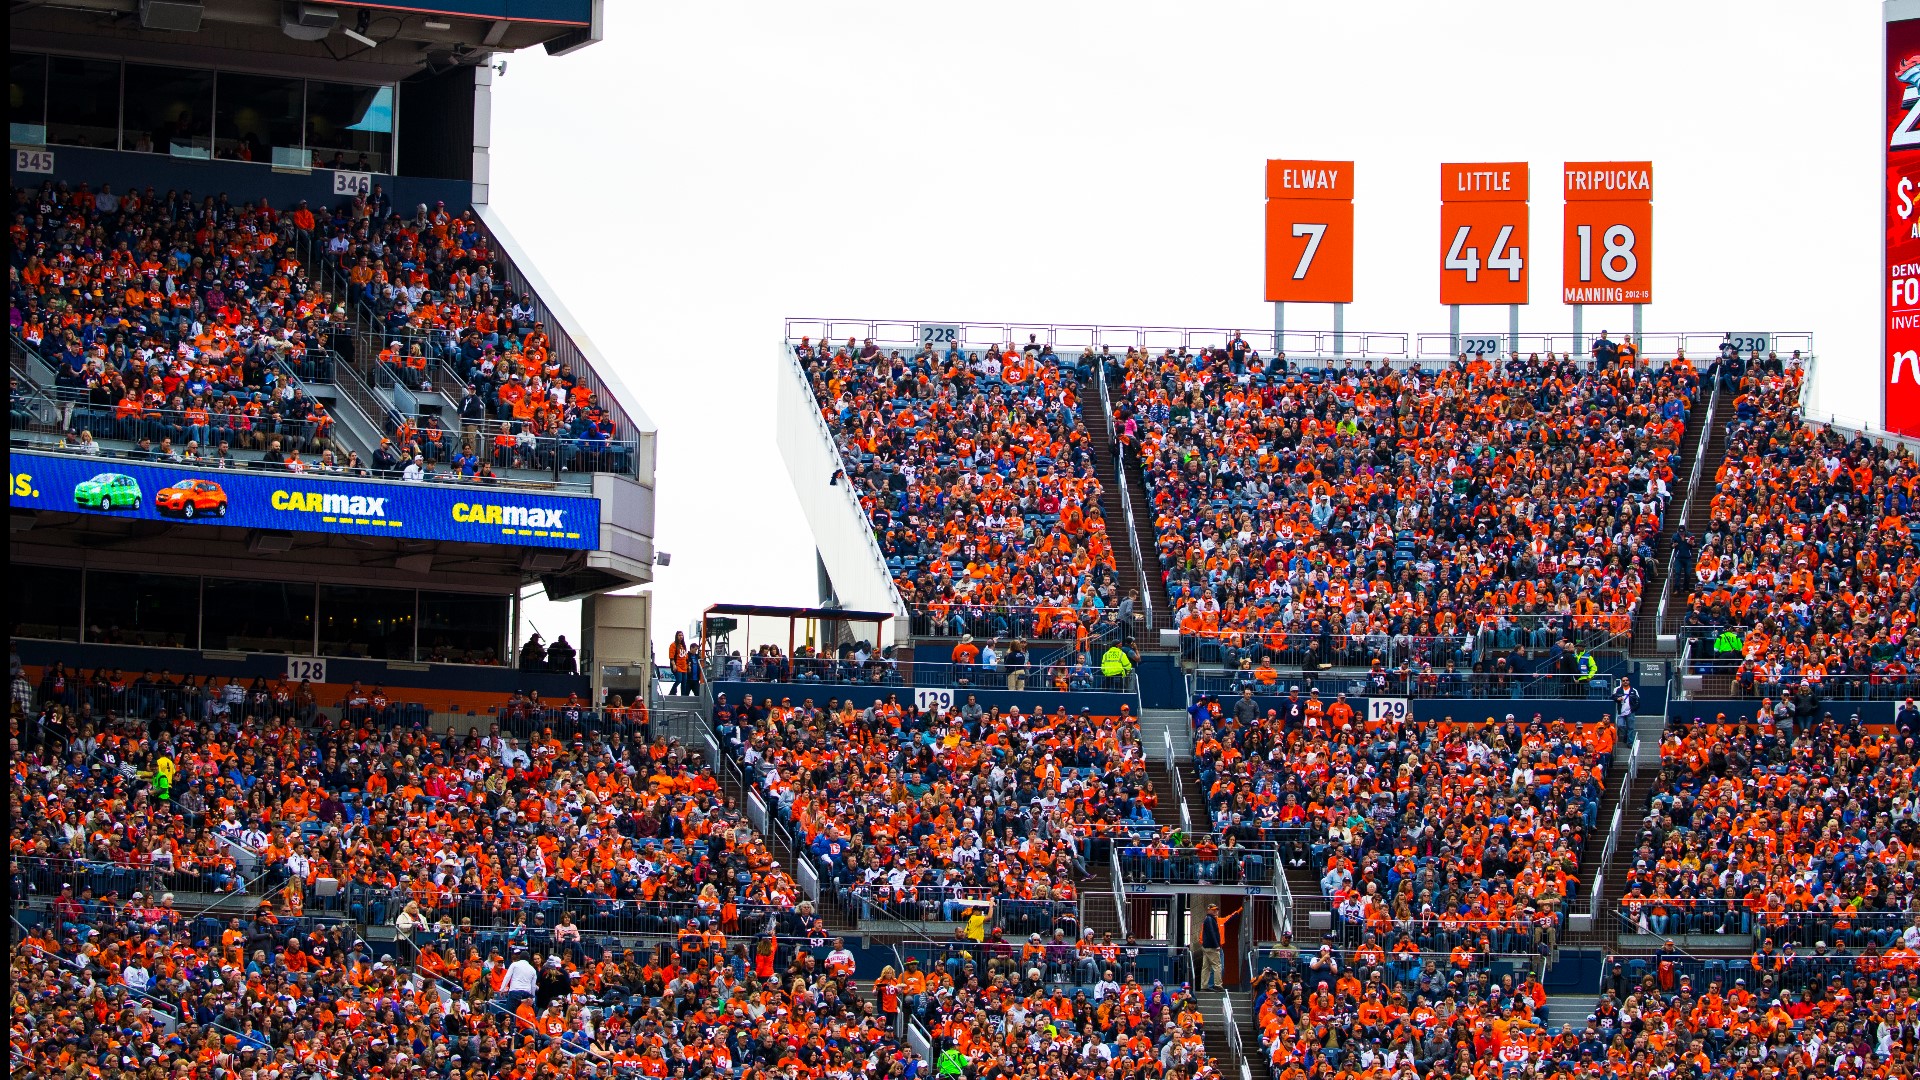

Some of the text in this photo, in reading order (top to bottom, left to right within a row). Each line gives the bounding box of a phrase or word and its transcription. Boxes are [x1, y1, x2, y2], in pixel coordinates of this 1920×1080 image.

[18, 152, 52, 170] 345
[336, 174, 369, 192] 346
[1283, 169, 1338, 189] ELWAY
[1458, 171, 1511, 191] LITTLE
[1566, 170, 1650, 190] TRIPUCKA
[1291, 222, 1328, 280] 7
[1444, 225, 1523, 282] 44
[1577, 224, 1638, 282] 18
[1565, 287, 1649, 302] MANNING 2012-15
[924, 328, 955, 342] 228
[1466, 340, 1496, 353] 229
[1734, 338, 1766, 352] 230
[964, 546, 975, 554] 58
[291, 661, 323, 680] 128
[918, 691, 951, 709] 129
[1291, 705, 1298, 716] 6
[1373, 702, 1405, 718] 129
[104, 754, 115, 764] 18
[962, 855, 973, 863] 10
[1131, 884, 1146, 892] 129
[1245, 886, 1260, 894] 129
[549, 1023, 562, 1033] 58
[717, 1056, 726, 1065] 18
